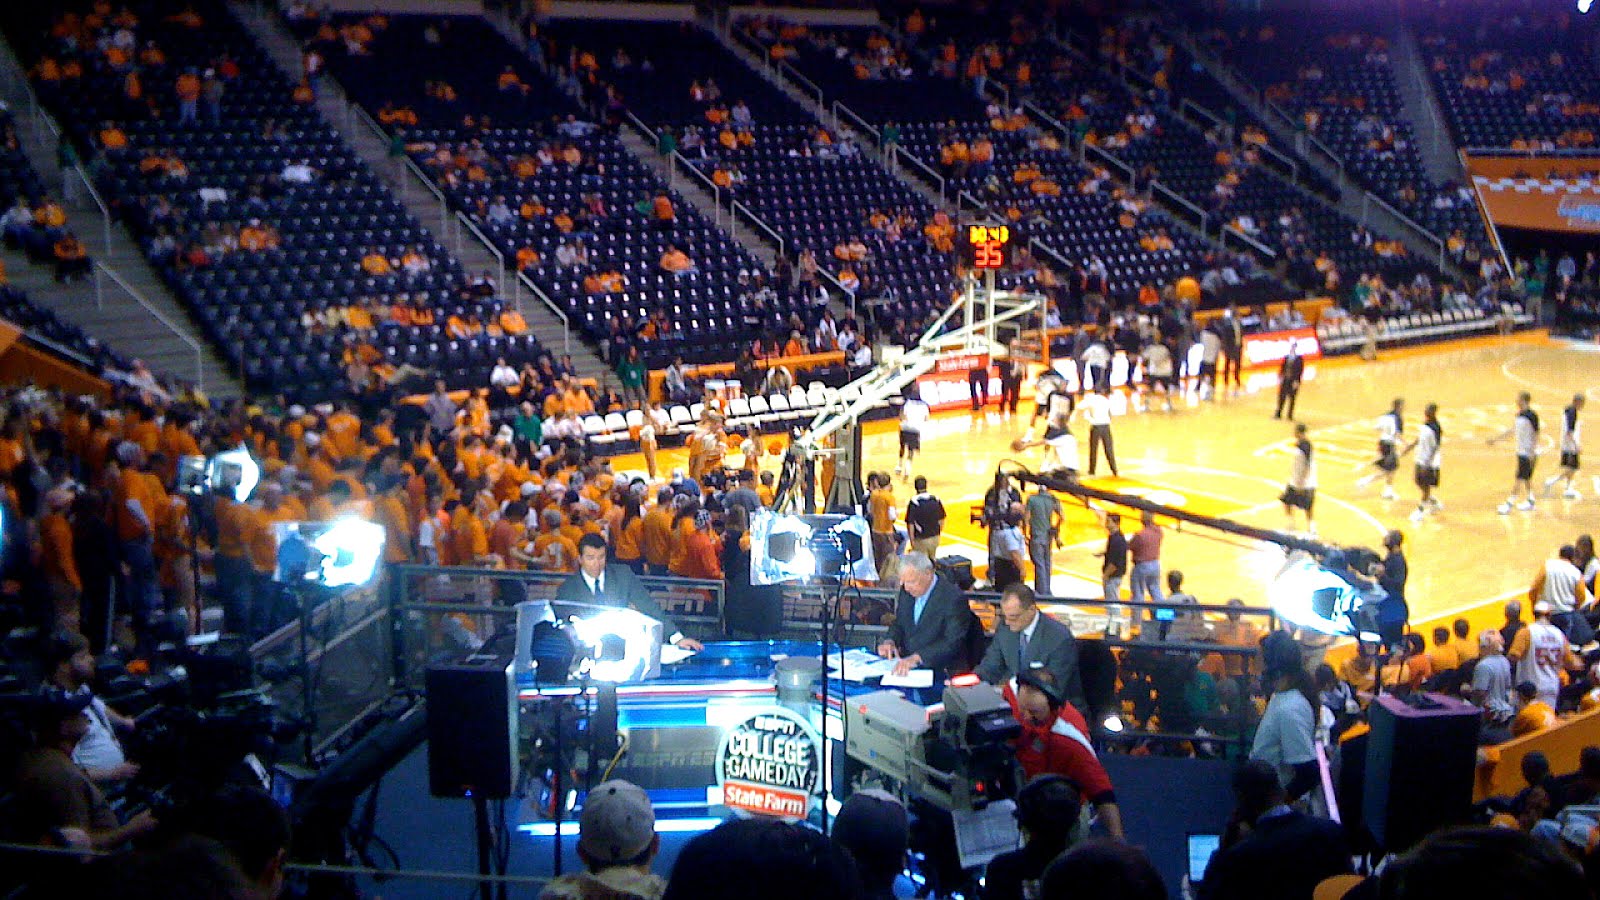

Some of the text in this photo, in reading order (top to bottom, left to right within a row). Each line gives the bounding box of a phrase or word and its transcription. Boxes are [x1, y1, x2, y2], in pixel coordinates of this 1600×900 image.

[975, 242, 1003, 267] 35
[728, 730, 809, 766] COLLEGE
[728, 756, 809, 789] GAMEDAY
[726, 786, 804, 815] State Farm
